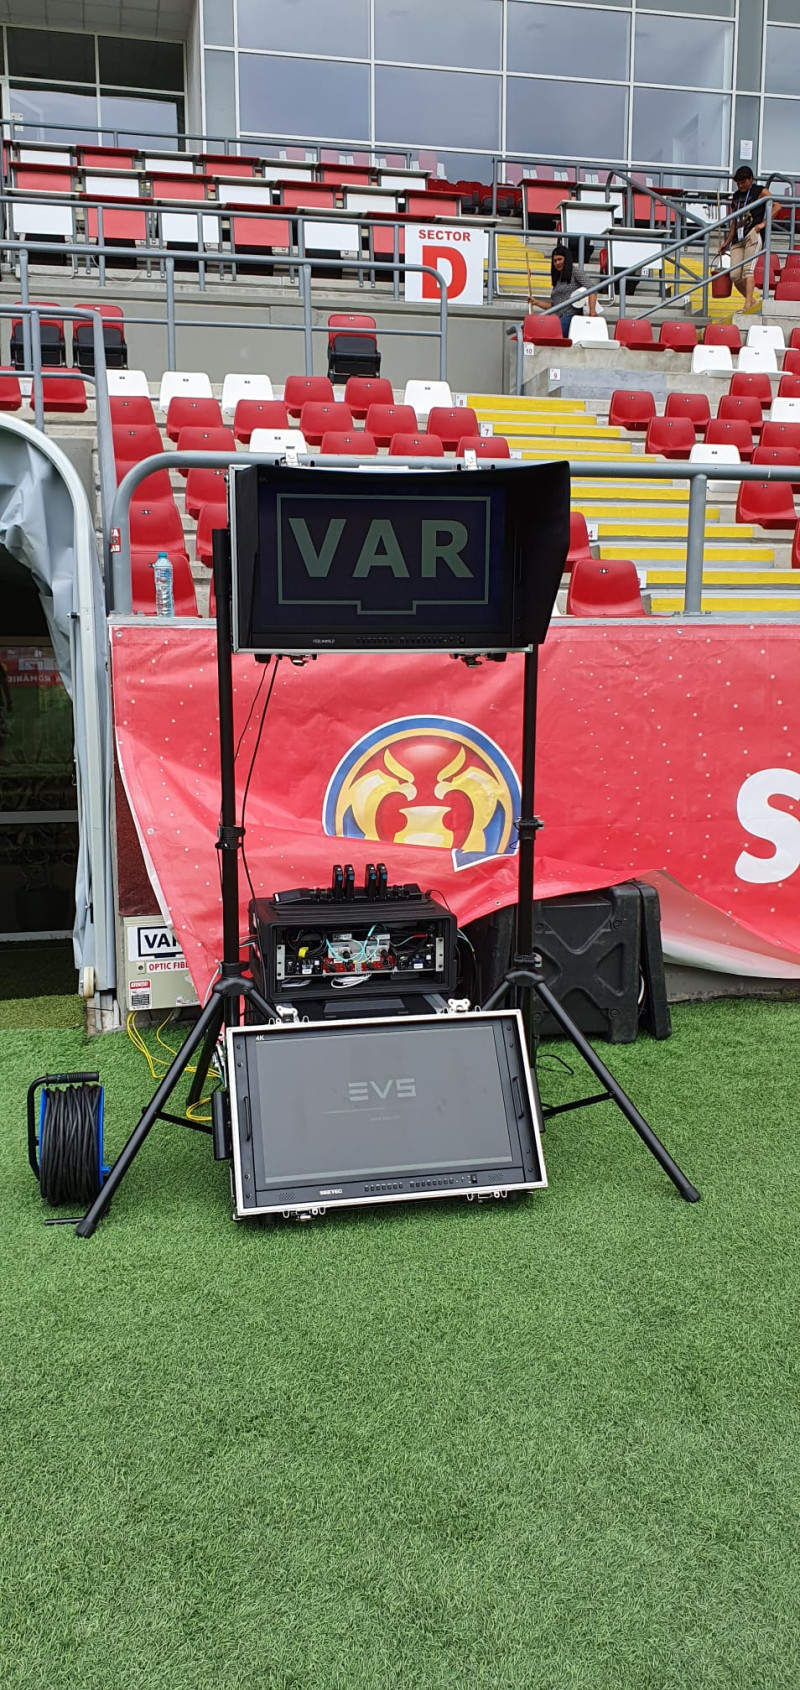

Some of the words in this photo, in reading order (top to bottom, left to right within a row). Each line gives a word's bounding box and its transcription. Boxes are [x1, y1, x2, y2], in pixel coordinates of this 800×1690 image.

[418, 229, 471, 242] SECTOR
[422, 244, 467, 299] D
[288, 518, 475, 578] VAR
[149, 962, 171, 971] OPTIC
[348, 1078, 416, 1101] EVS
